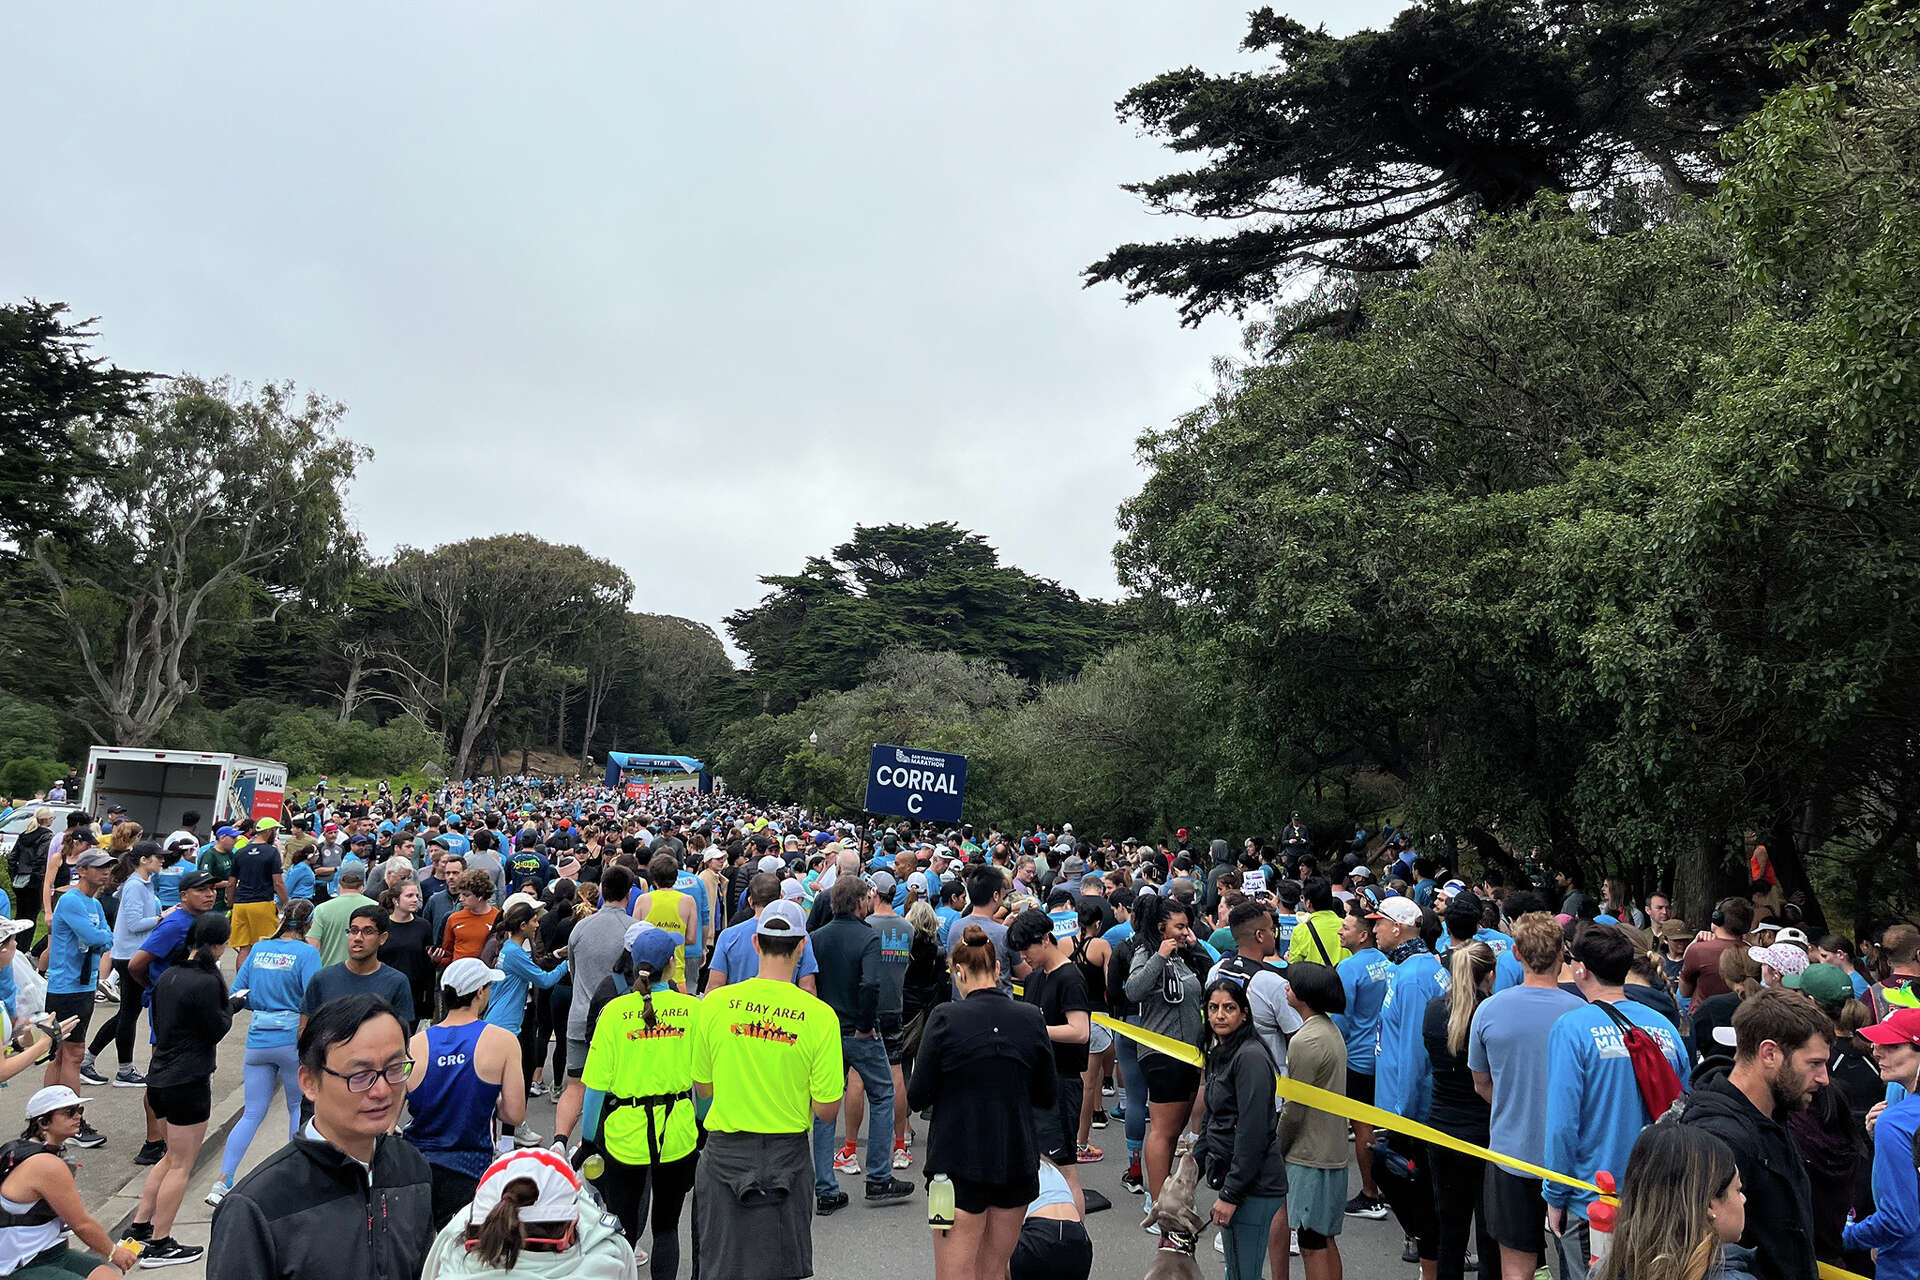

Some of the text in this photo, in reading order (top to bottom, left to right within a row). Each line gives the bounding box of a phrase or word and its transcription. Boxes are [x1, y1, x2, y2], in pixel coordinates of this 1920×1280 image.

[911, 758, 945, 768] MARATHON
[876, 765, 958, 795] CORRAL
[907, 793, 923, 814] C
[656, 921, 680, 929] Achilles
[622, 1010, 633, 1020] SF
[661, 1008, 689, 1017] AREA
[728, 999, 805, 1022] SF BAY AREA
[1590, 1025, 1616, 1037] SAN
[437, 1053, 466, 1067] CRC
